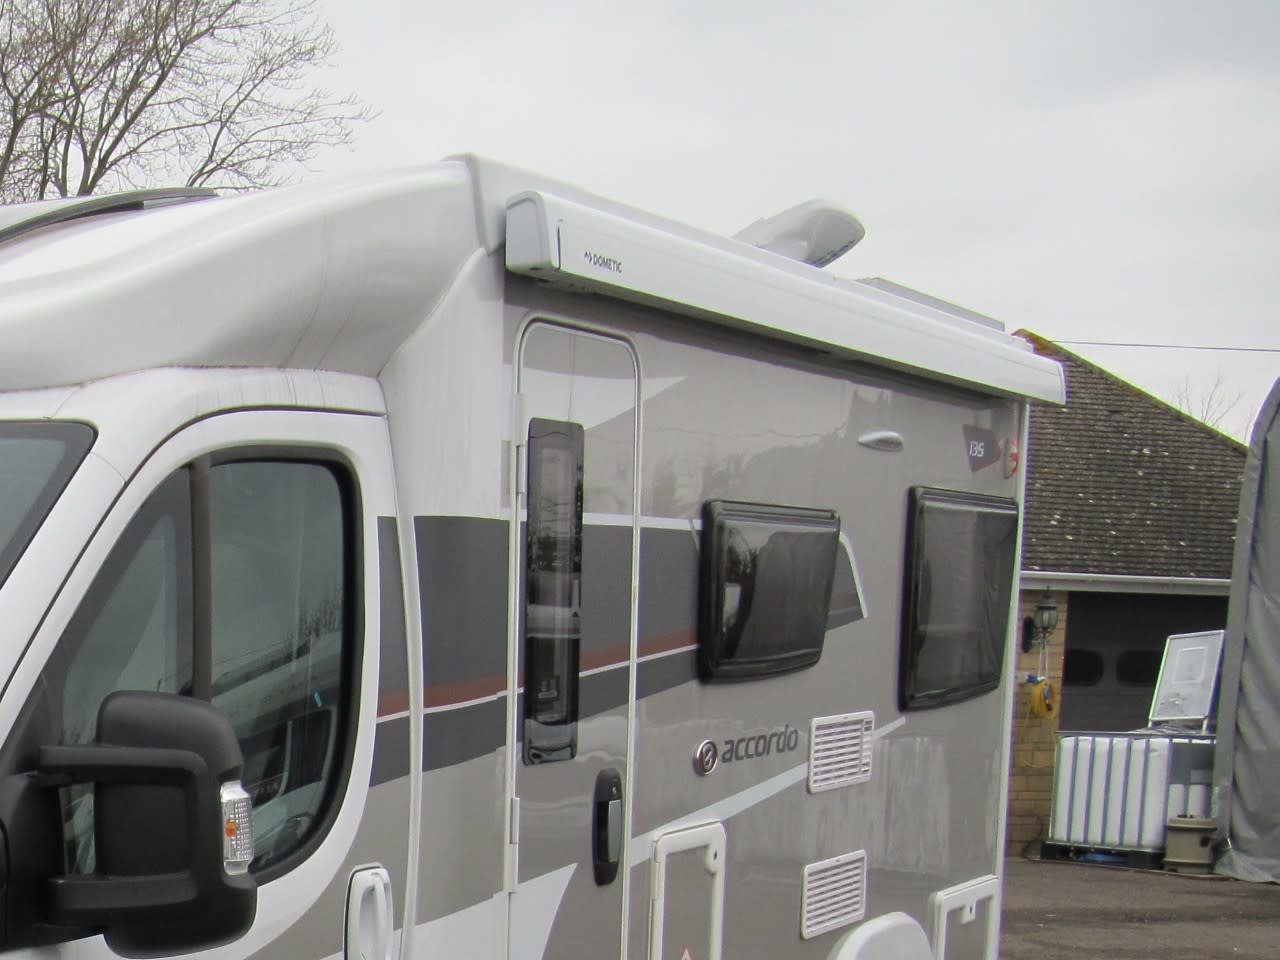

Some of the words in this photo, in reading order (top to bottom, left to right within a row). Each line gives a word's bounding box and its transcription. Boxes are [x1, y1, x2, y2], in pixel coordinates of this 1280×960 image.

[593, 254, 622, 273] DOMETIC
[970, 440, 984, 457] 135
[721, 724, 798, 763] accordo
